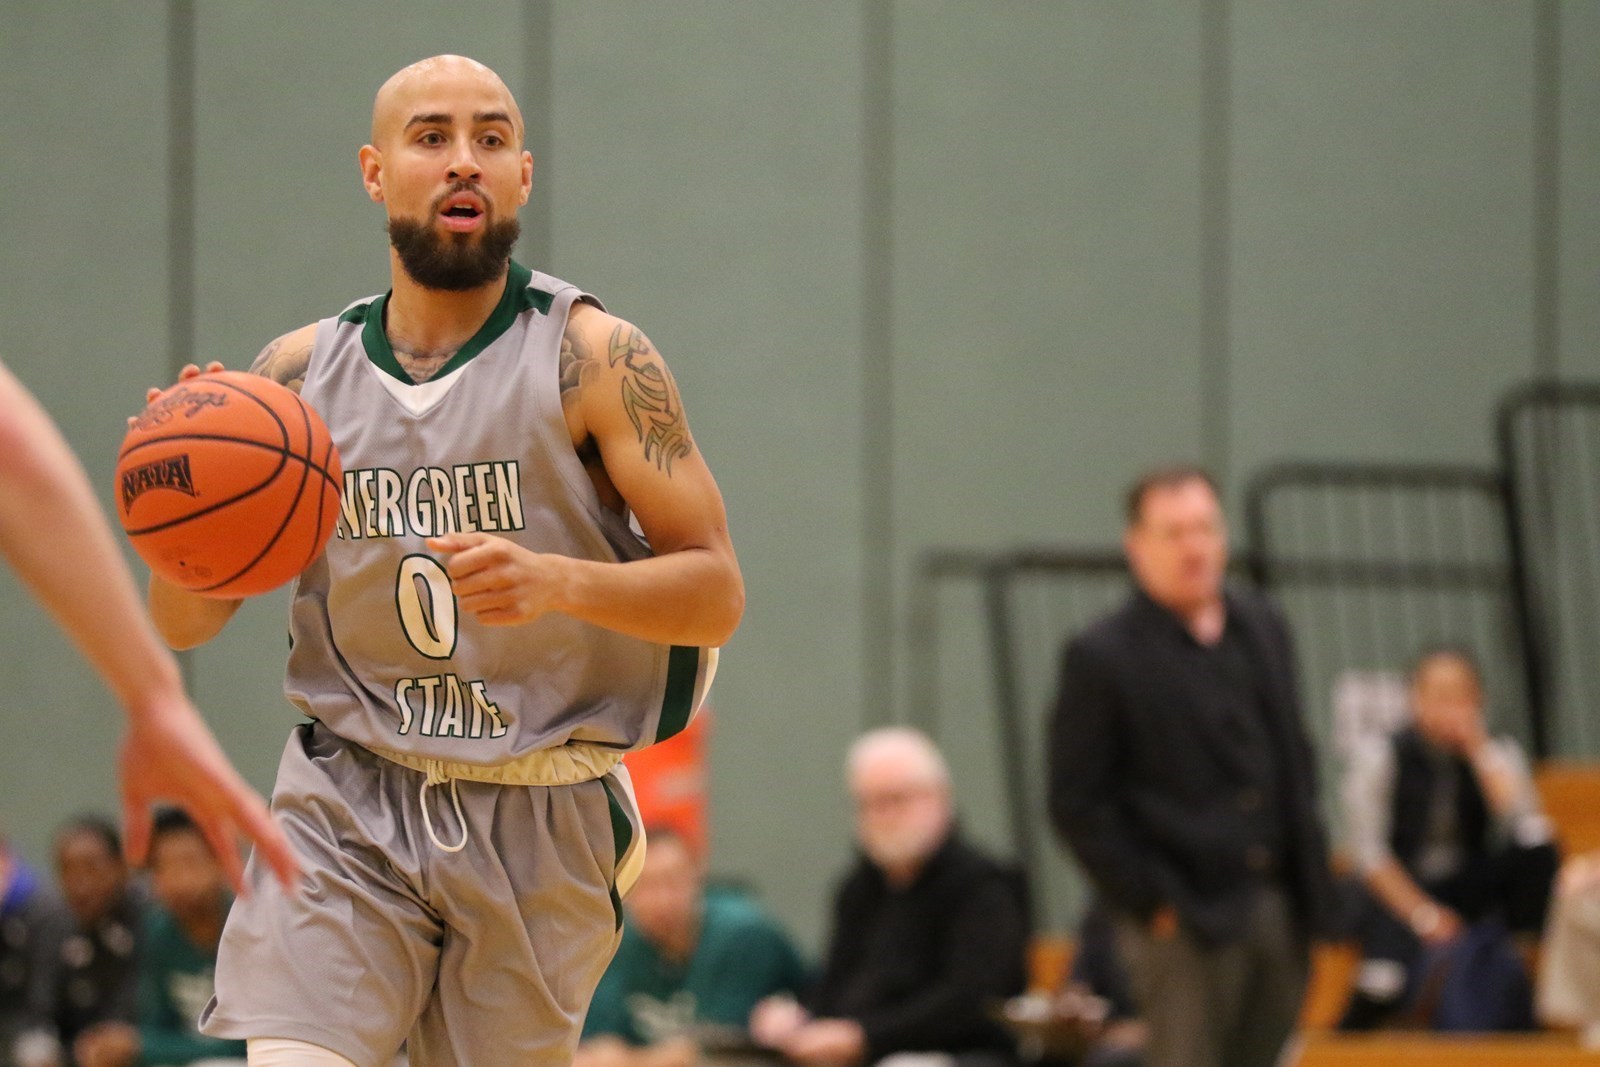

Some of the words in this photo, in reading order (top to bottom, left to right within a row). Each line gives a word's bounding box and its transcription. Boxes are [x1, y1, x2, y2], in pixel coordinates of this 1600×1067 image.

[122, 453, 196, 515] NAIA
[336, 460, 525, 539] VERGREEN
[395, 553, 458, 660] 0
